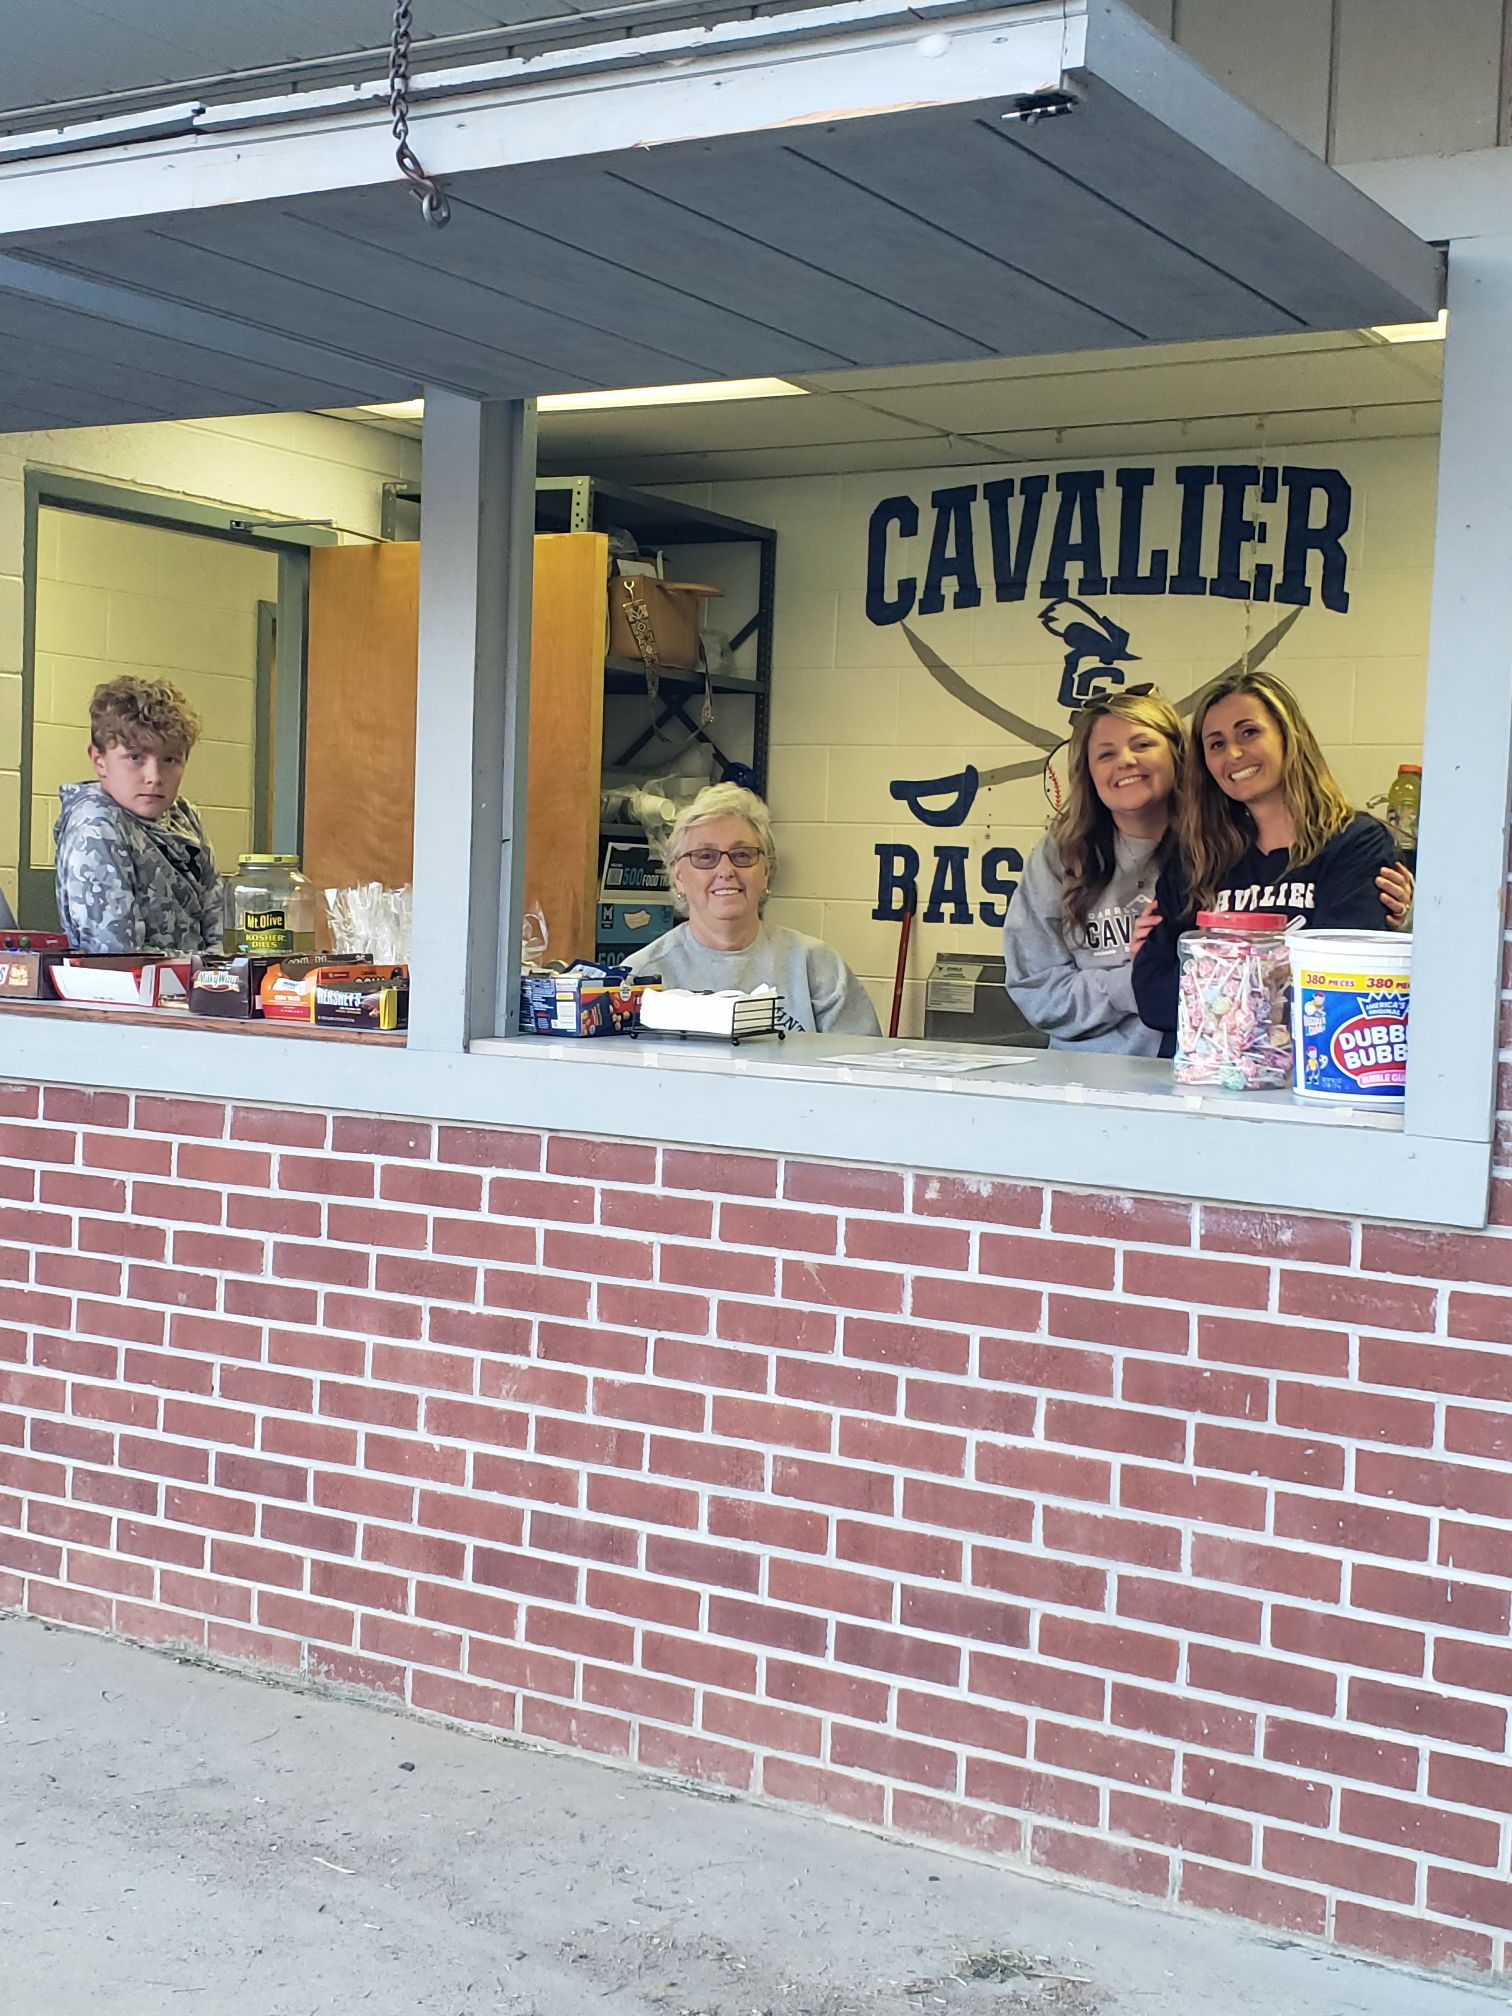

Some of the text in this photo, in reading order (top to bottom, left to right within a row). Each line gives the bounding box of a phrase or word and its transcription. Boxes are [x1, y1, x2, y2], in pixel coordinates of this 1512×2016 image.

[865, 465, 1352, 626] CAVALIER
[623, 868, 644, 886] 500
[642, 874, 659, 887] FOOD
[871, 844, 1025, 928] BAS
[260, 914, 283, 929] Olive
[245, 934, 286, 942] KOSHER
[1085, 914, 1133, 949] CAV
[199, 972, 237, 985] Milky Way
[1306, 974, 1326, 985] 380
[1328, 979, 1355, 988] PIECES
[1366, 977, 1394, 989] 380
[316, 986, 363, 1007] HERSHEY'S
[1365, 1001, 1406, 1010] AMERICA'S
[1338, 1024, 1408, 1051] DUBB
[1343, 1043, 1408, 1070] BUBB
[1391, 1073, 1406, 1083] GU
